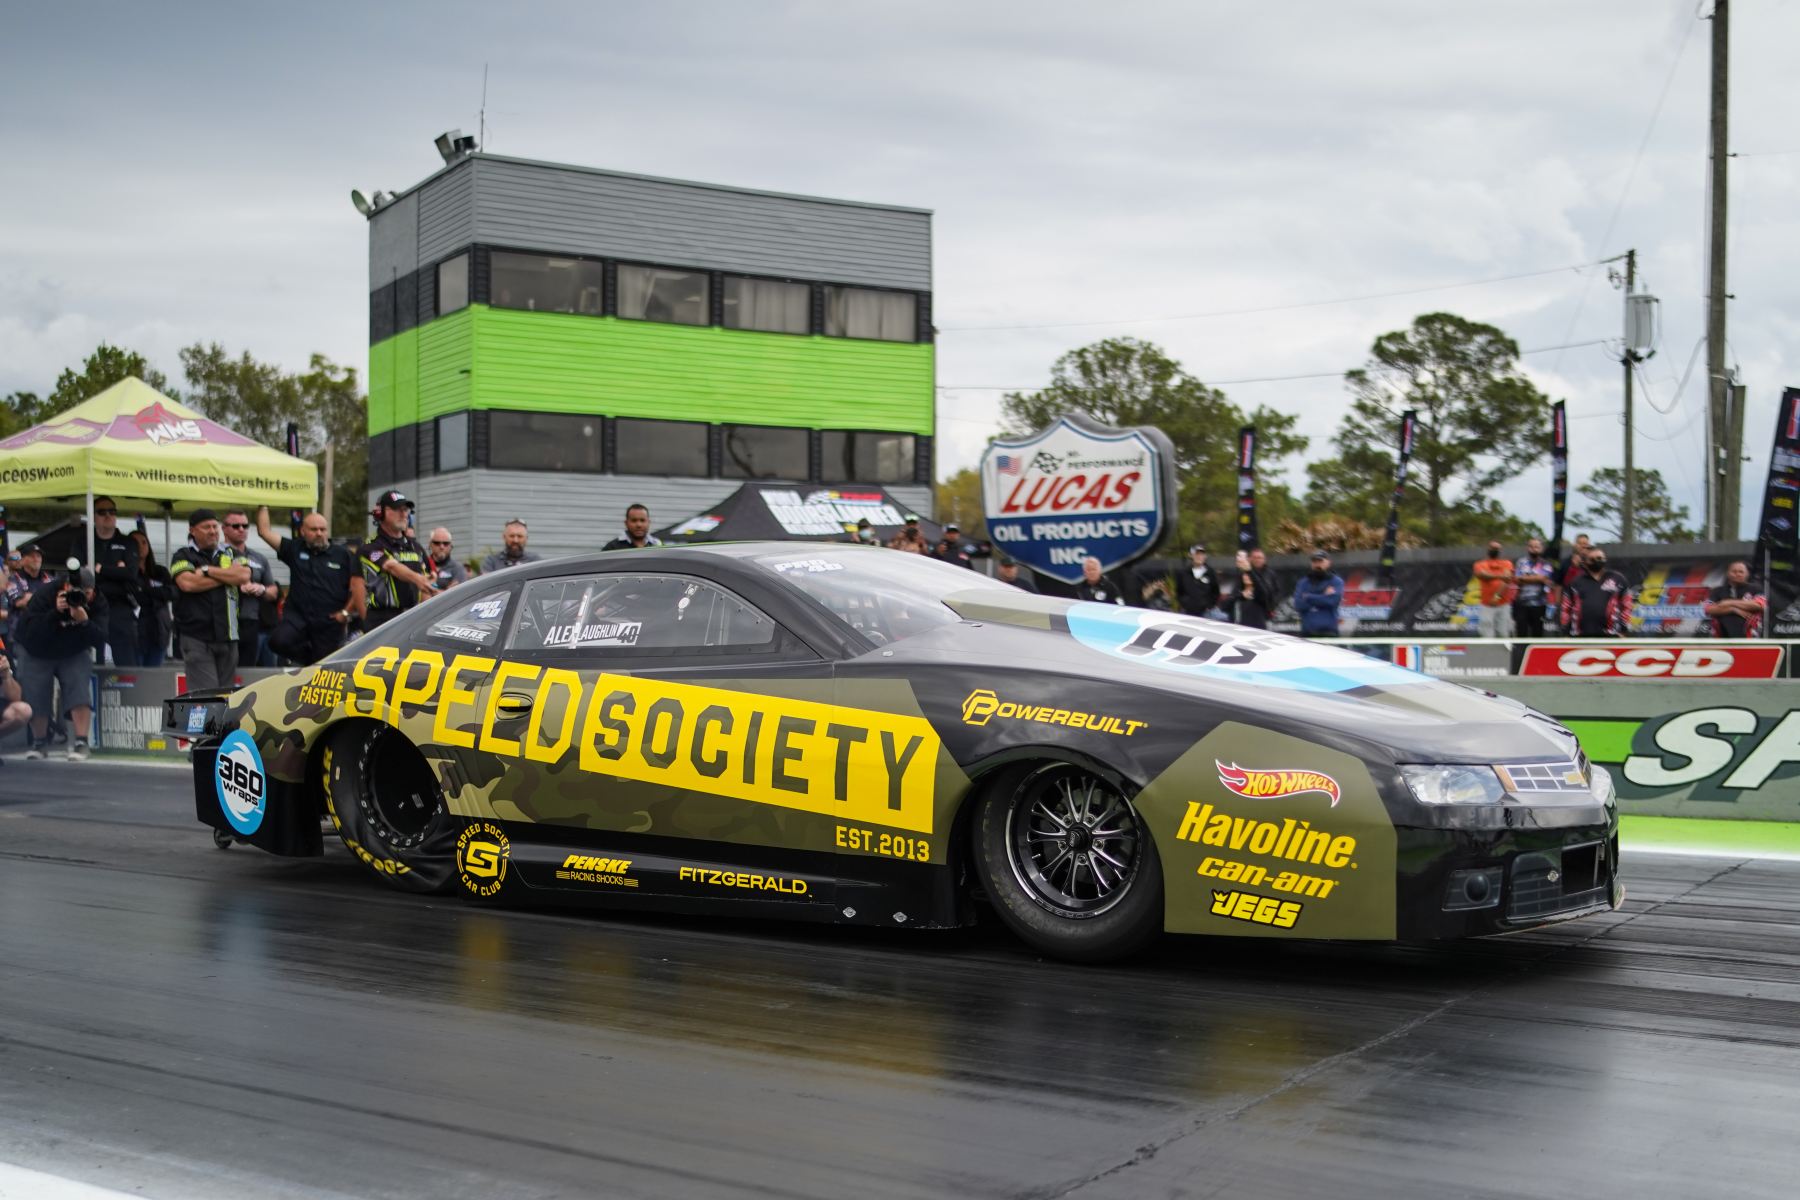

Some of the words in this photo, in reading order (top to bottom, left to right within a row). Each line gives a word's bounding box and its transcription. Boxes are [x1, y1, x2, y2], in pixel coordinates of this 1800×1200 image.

[146, 419, 202, 445] WMS
[1001, 471, 1141, 513] LUCAS
[993, 524, 1028, 542] OIL
[1032, 518, 1150, 541] PRODUCTS
[543, 625, 578, 646] ALEX
[1557, 649, 1735, 677] CCD
[311, 669, 347, 690] DRIVE
[299, 685, 342, 708] FASTER
[102, 705, 163, 735] DOORSLAMM
[962, 689, 1143, 736] POWERBUILT
[345, 646, 583, 764] SPEED
[593, 690, 925, 811] SOCIETY
[218, 754, 264, 798] 360
[223, 780, 259, 807] wraps
[457, 823, 481, 849] SPEED
[484, 823, 510, 858] SOCIETY
[835, 825, 930, 862] EST.2013
[1176, 800, 1356, 868] Havoline
[562, 854, 632, 875] PENSKE
[570, 871, 595, 883] RACING
[595, 872, 624, 886] SHOCKS
[1197, 857, 1336, 899] can-am
[461, 873, 478, 894] CAR
[480, 881, 502, 897] CLUB
[679, 866, 808, 894] FITZGERALD
[1211, 890, 1303, 928] JEGS
